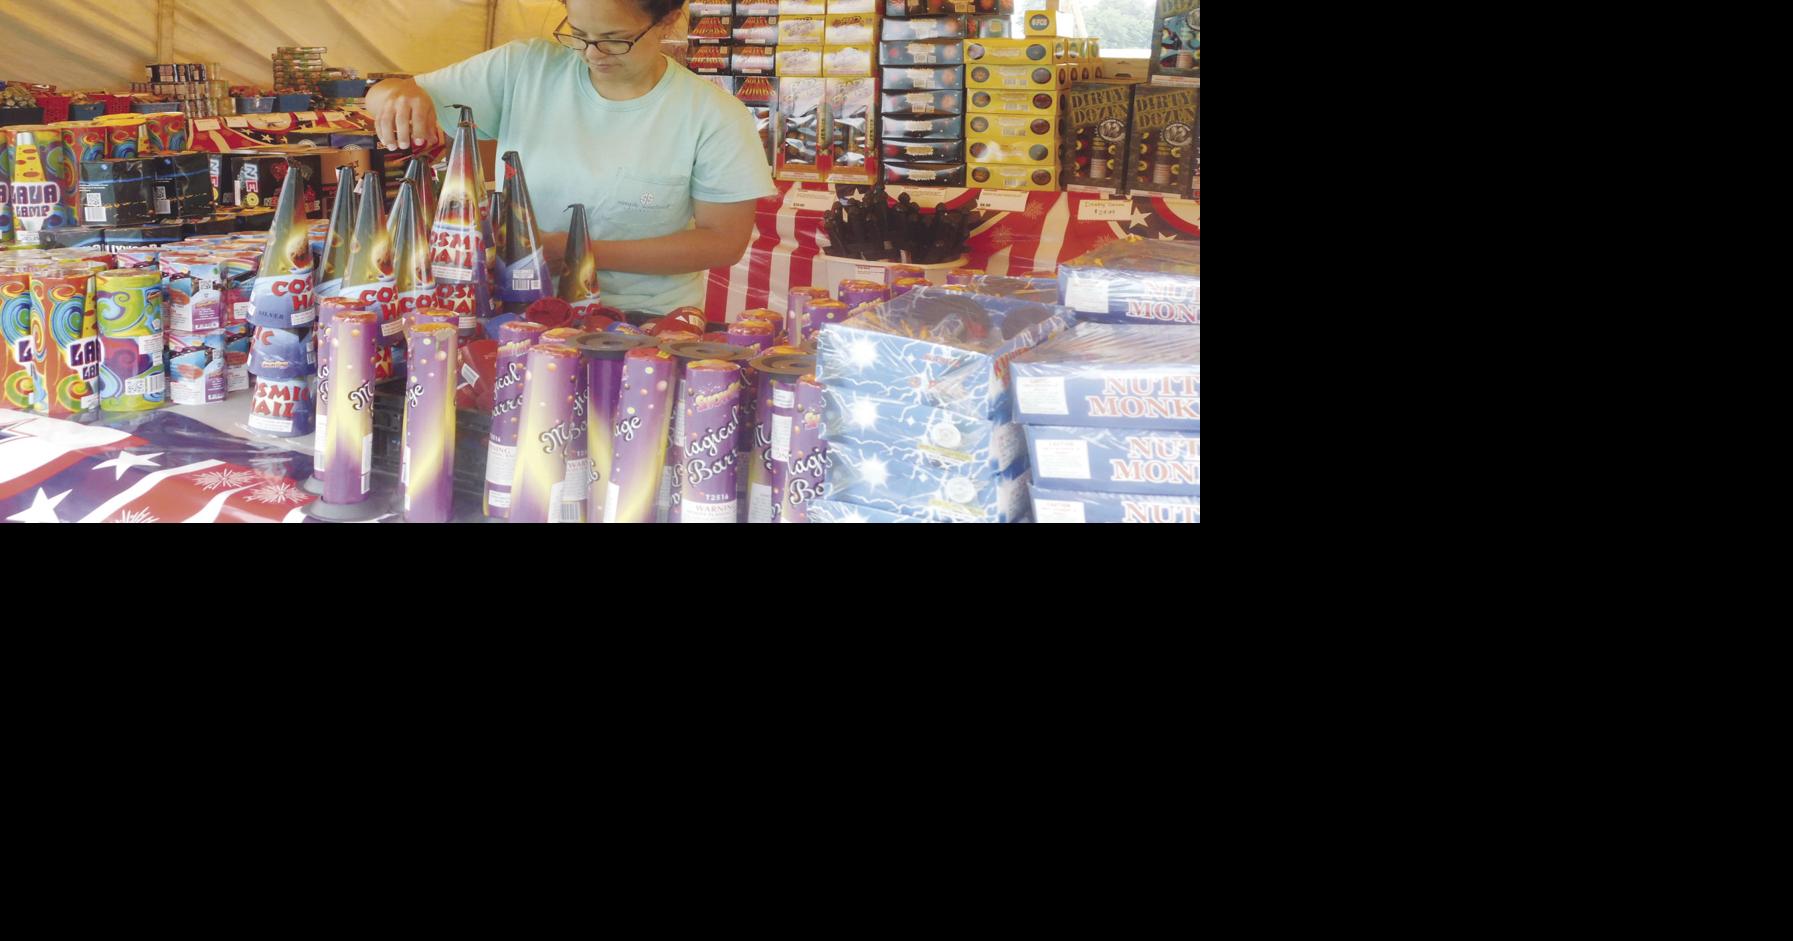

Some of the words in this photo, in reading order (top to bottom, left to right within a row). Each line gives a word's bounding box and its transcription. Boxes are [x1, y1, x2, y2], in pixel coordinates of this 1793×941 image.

[1071, 87, 1128, 109] DIRTY
[1136, 89, 1195, 113] DIRTY
[1072, 103, 1128, 126] DOZEN
[1137, 107, 1197, 130] DOZEN
[252, 382, 311, 402] SMIC
